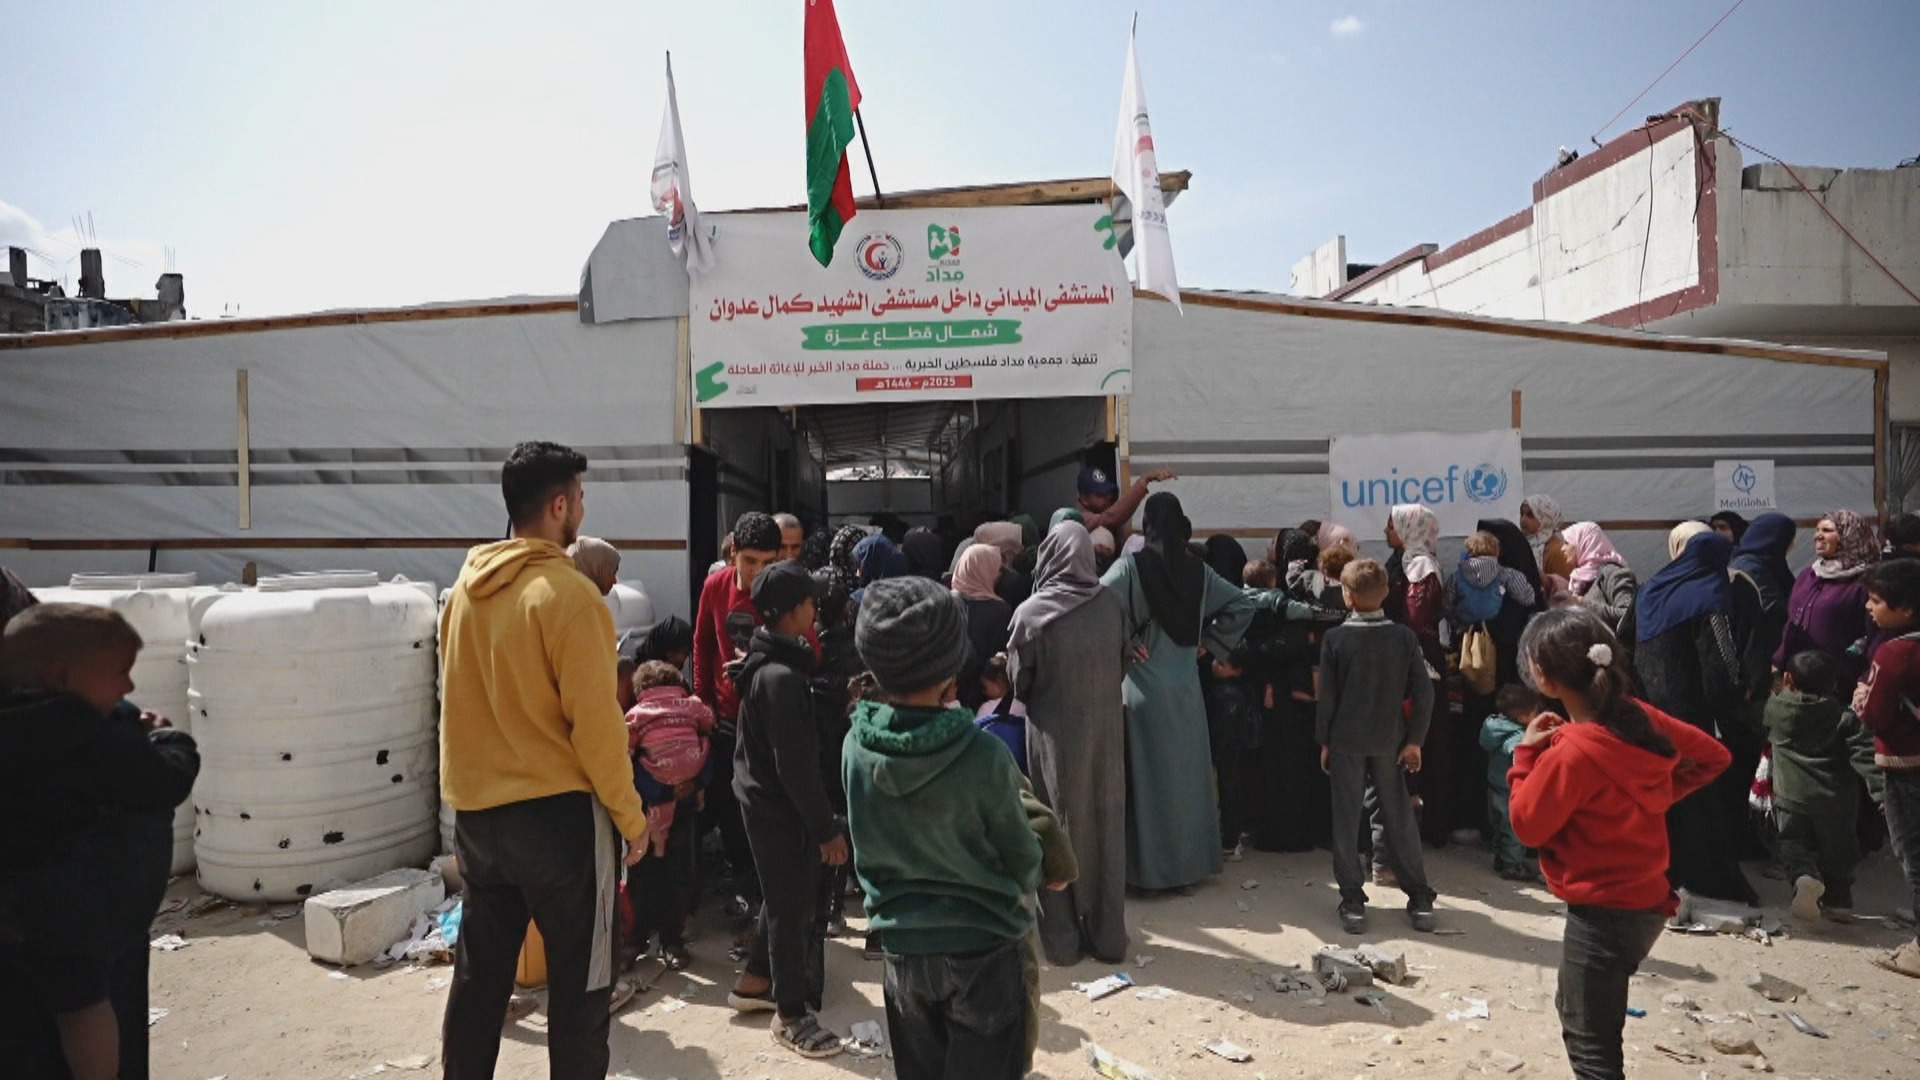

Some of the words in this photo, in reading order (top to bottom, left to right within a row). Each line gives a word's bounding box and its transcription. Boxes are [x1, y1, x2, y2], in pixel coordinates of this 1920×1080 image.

[926, 267, 964, 282] مداد
[762, 293, 813, 319] كمال
[817, 289, 868, 317] الشهيد
[872, 288, 938, 316] مستشفى
[942, 287, 981, 313] داخل
[985, 286, 1041, 316] الميداني
[1044, 283, 1114, 312] المستشفى
[710, 296, 759, 321] عدوان
[825, 328, 869, 346] غزة
[873, 326, 932, 346] قطاع
[935, 323, 998, 342] شمال
[808, 360, 832, 376] الخير
[836, 360, 859, 372] مداد
[863, 360, 889, 370] حملة
[905, 358, 941, 372] الخيرية
[945, 355, 997, 370] فلسطين
[1000, 355, 1024, 367] مداد
[1027, 355, 1062, 368] جمعية
[1071, 353, 1098, 366] تنفيذ
[769, 361, 805, 377] للإغاثة
[1342, 465, 1459, 507] unicef
[1720, 497, 1771, 508] MedGlobal
